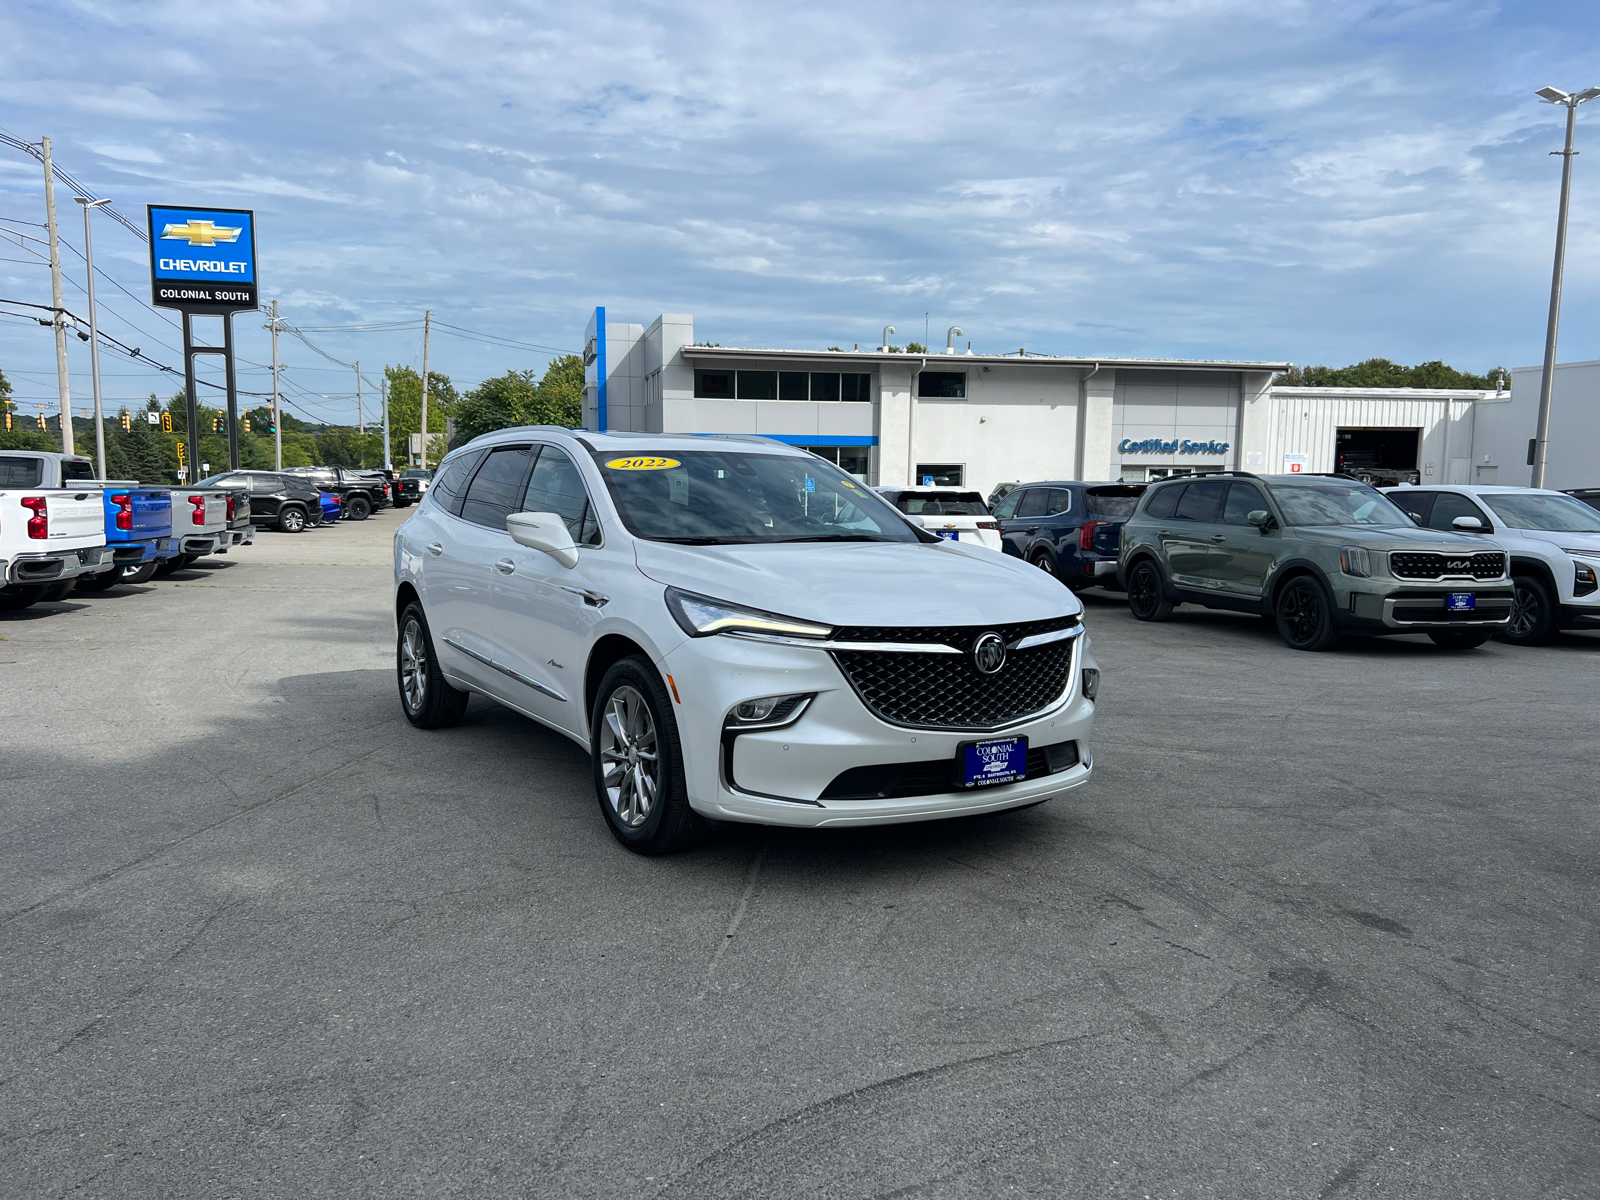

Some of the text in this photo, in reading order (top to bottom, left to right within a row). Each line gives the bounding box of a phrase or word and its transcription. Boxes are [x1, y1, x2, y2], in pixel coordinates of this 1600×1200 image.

[159, 258, 248, 274] CHEVROLET
[160, 289, 250, 301] COLONIAL SOUTH
[1121, 438, 1230, 452] Certified Service
[619, 458, 667, 469] 2022
[976, 744, 1014, 756] COLONIAL
[982, 752, 1009, 763] SOUTH
